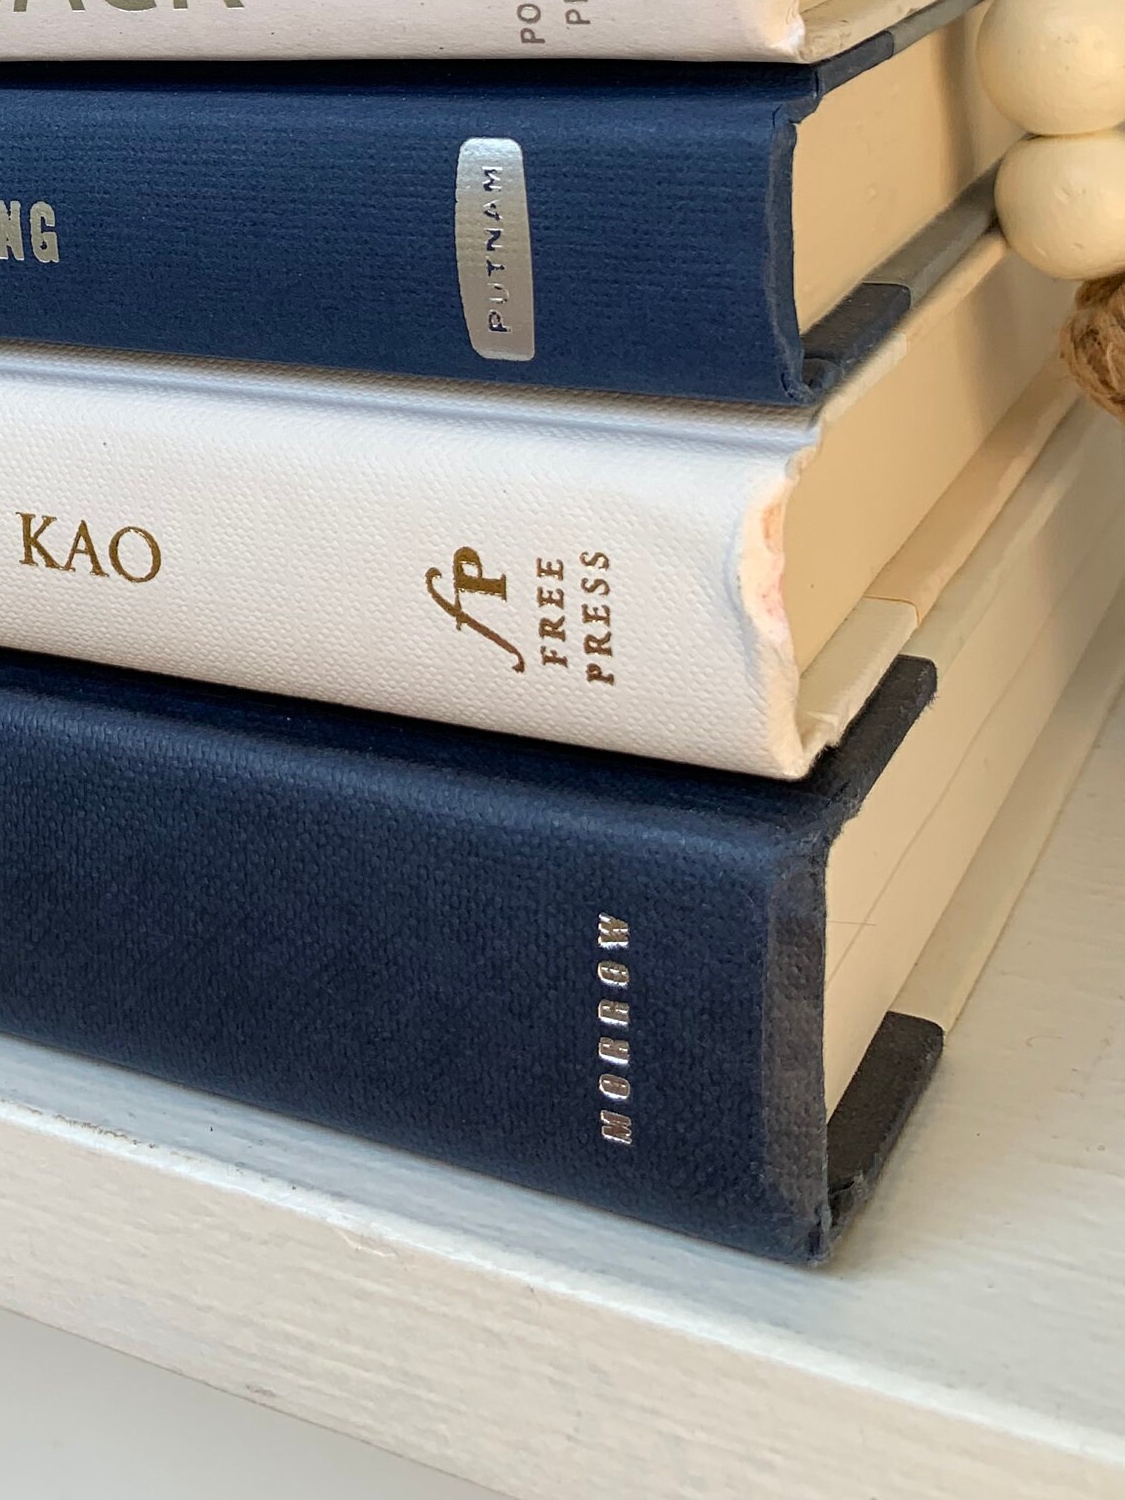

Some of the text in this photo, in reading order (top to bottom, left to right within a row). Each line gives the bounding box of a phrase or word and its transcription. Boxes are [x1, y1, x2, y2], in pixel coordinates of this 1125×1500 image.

[482, 164, 513, 335] PUTNAM
[19, 511, 163, 584] KAO
[536, 556, 569, 668] FREE
[579, 550, 616, 687] PRESS
[597, 911, 633, 1145] MORROW
